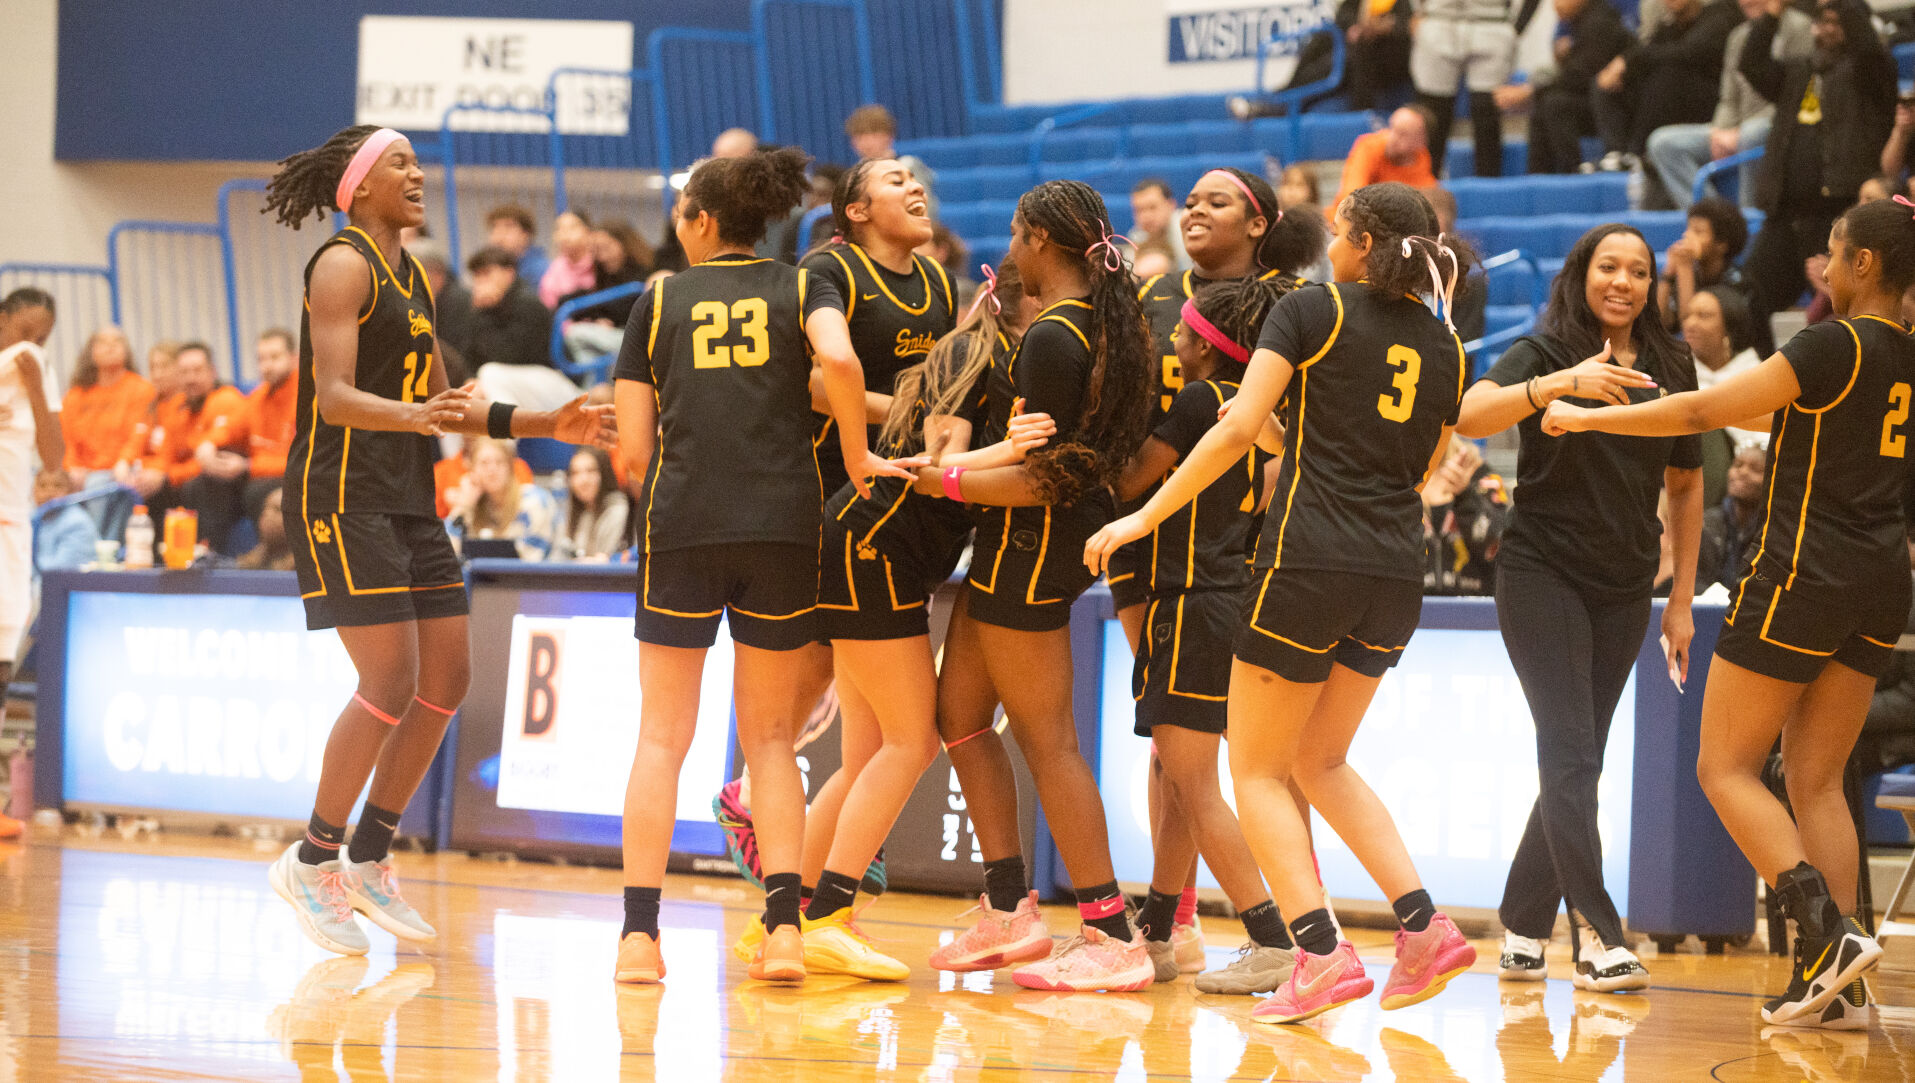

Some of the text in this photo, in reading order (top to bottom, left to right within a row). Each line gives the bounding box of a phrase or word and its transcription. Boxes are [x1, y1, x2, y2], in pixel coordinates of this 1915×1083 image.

[464, 33, 527, 72] NE
[357, 82, 437, 112] EXIT
[692, 297, 770, 369] 23
[894, 328, 938, 358] Snide
[1377, 344, 1422, 423] 3
[1880, 382, 1912, 458] 2
[124, 626, 299, 681] WELCOME
[524, 632, 559, 737] B
[103, 691, 332, 783] CARROL
[1363, 673, 1536, 736] OF TH
